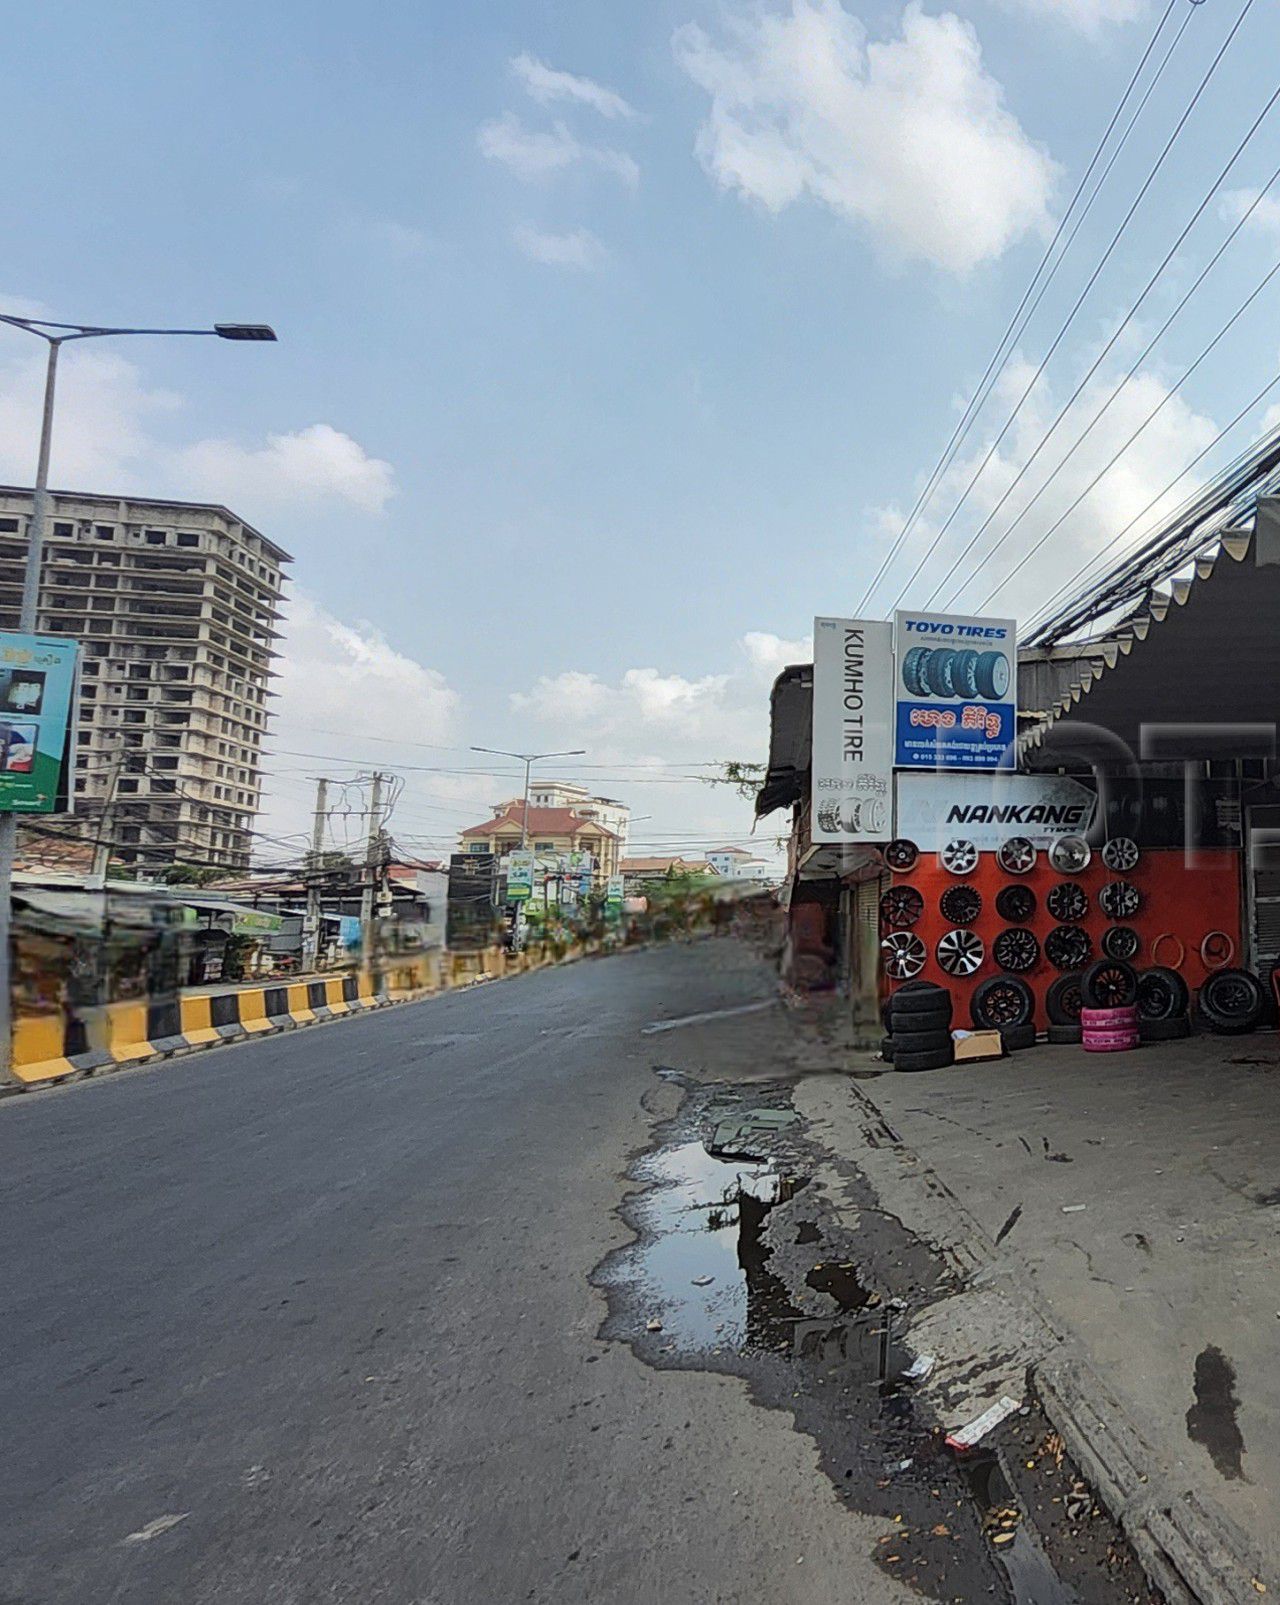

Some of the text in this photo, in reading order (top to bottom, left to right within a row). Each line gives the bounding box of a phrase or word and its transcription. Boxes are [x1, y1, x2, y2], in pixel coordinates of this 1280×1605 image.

[905, 620, 1007, 639] TOYO TIRES
[843, 628, 864, 762] KUMHO TIRE
[946, 804, 1086, 824] NANKANG
